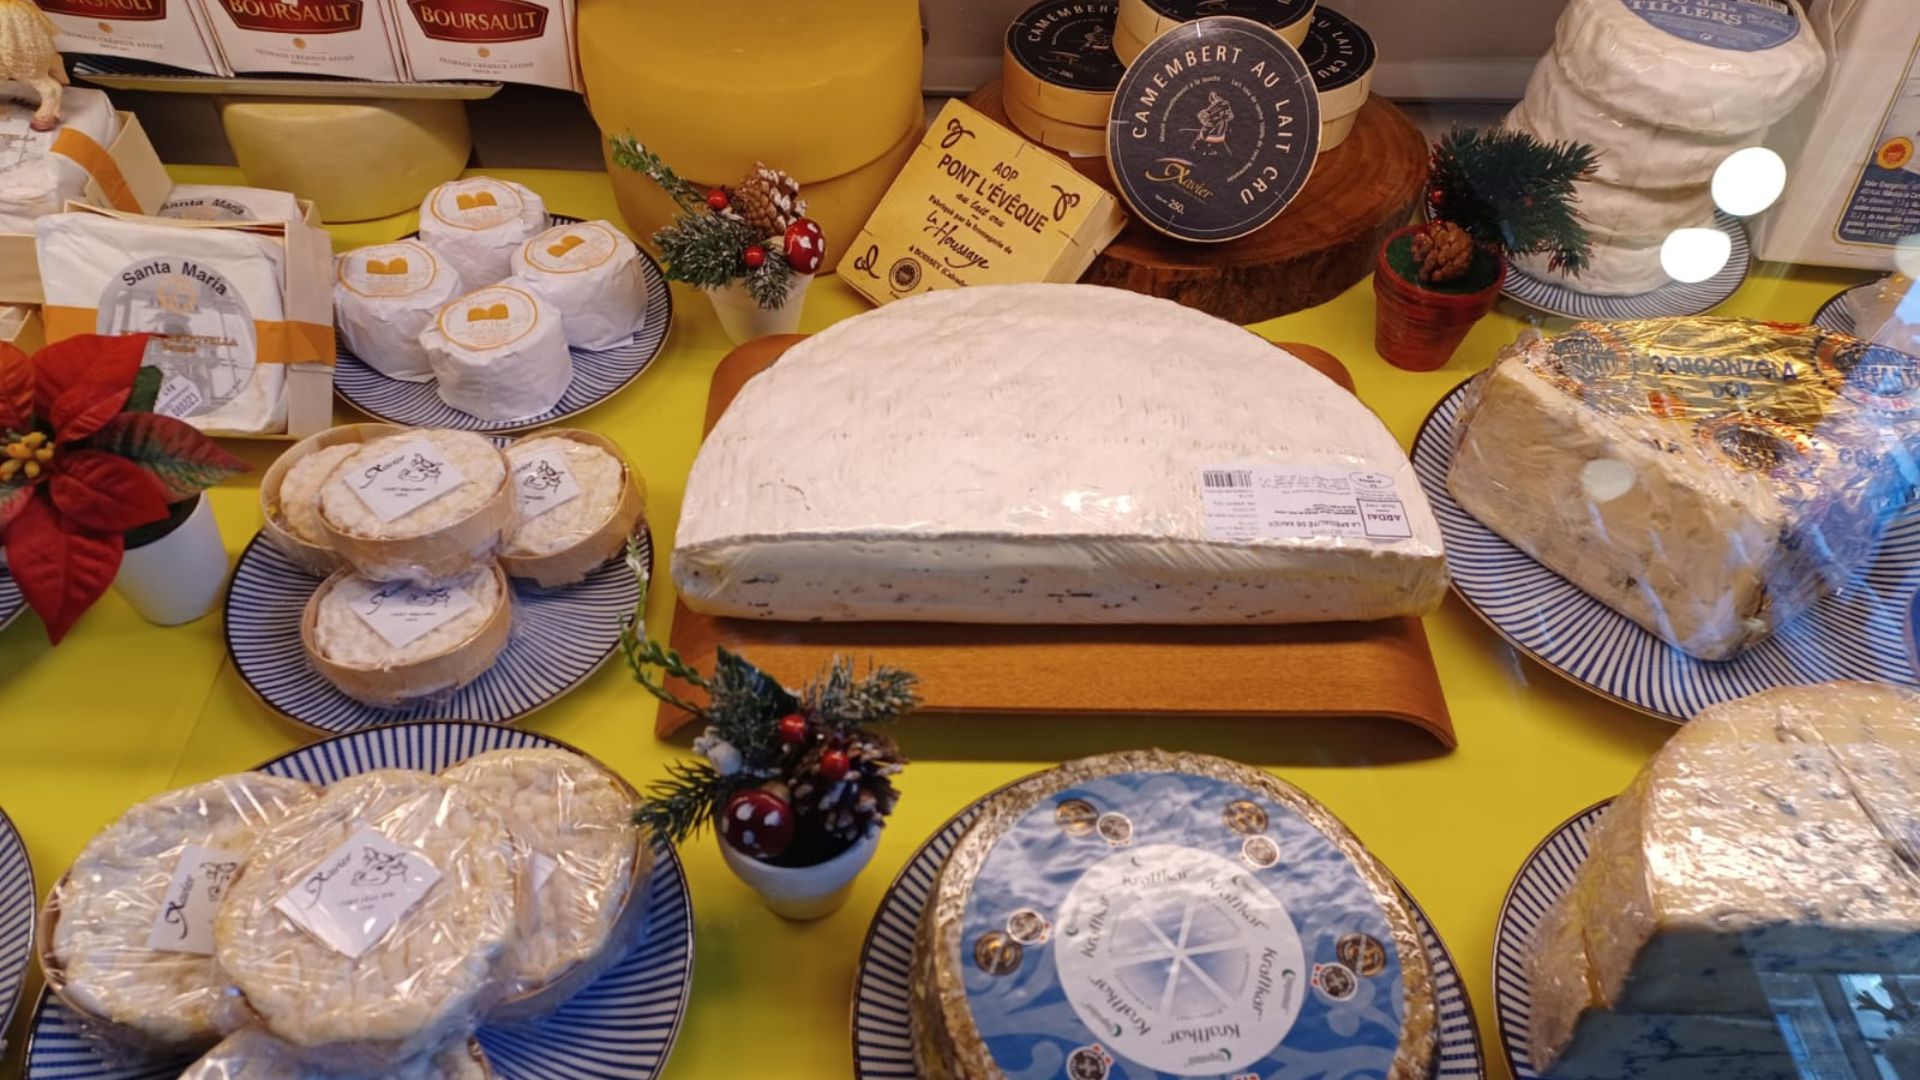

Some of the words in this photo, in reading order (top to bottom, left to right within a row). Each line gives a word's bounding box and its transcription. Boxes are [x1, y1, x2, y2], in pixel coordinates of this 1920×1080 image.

[231, 0, 350, 22] BOURSAULT
[421, 5, 536, 31] BOURSAULT
[1331, 31, 1353, 55] LAIT
[1251, 61, 1280, 88] AU
[1317, 59, 1347, 79] CRU
[1132, 45, 1244, 139] CAMEMBERT
[1275, 99, 1294, 154] LAIT
[992, 161, 1019, 182] AOP
[1145, 162, 1214, 198] Xavier
[1240, 166, 1279, 205] CRU
[937, 153, 980, 187] PONT
[976, 178, 1049, 234] L'ÉVÊQUE
[956, 193, 970, 204] au
[970, 200, 990, 216] lait
[989, 214, 1006, 228] cru
[1003, 246, 1013, 255] de
[122, 261, 171, 287] Santa
[181, 261, 228, 296] Maria
[1650, 355, 1797, 382] GORGONZOLA
[1709, 381, 1752, 398] DOP
[305, 852, 352, 910] Xavier
[164, 874, 195, 940] Xavier
[1252, 946, 1279, 1013] Kraftkar
[1092, 978, 1152, 1037] Kraftkar
[1168, 1023, 1241, 1043] Kraftkar
